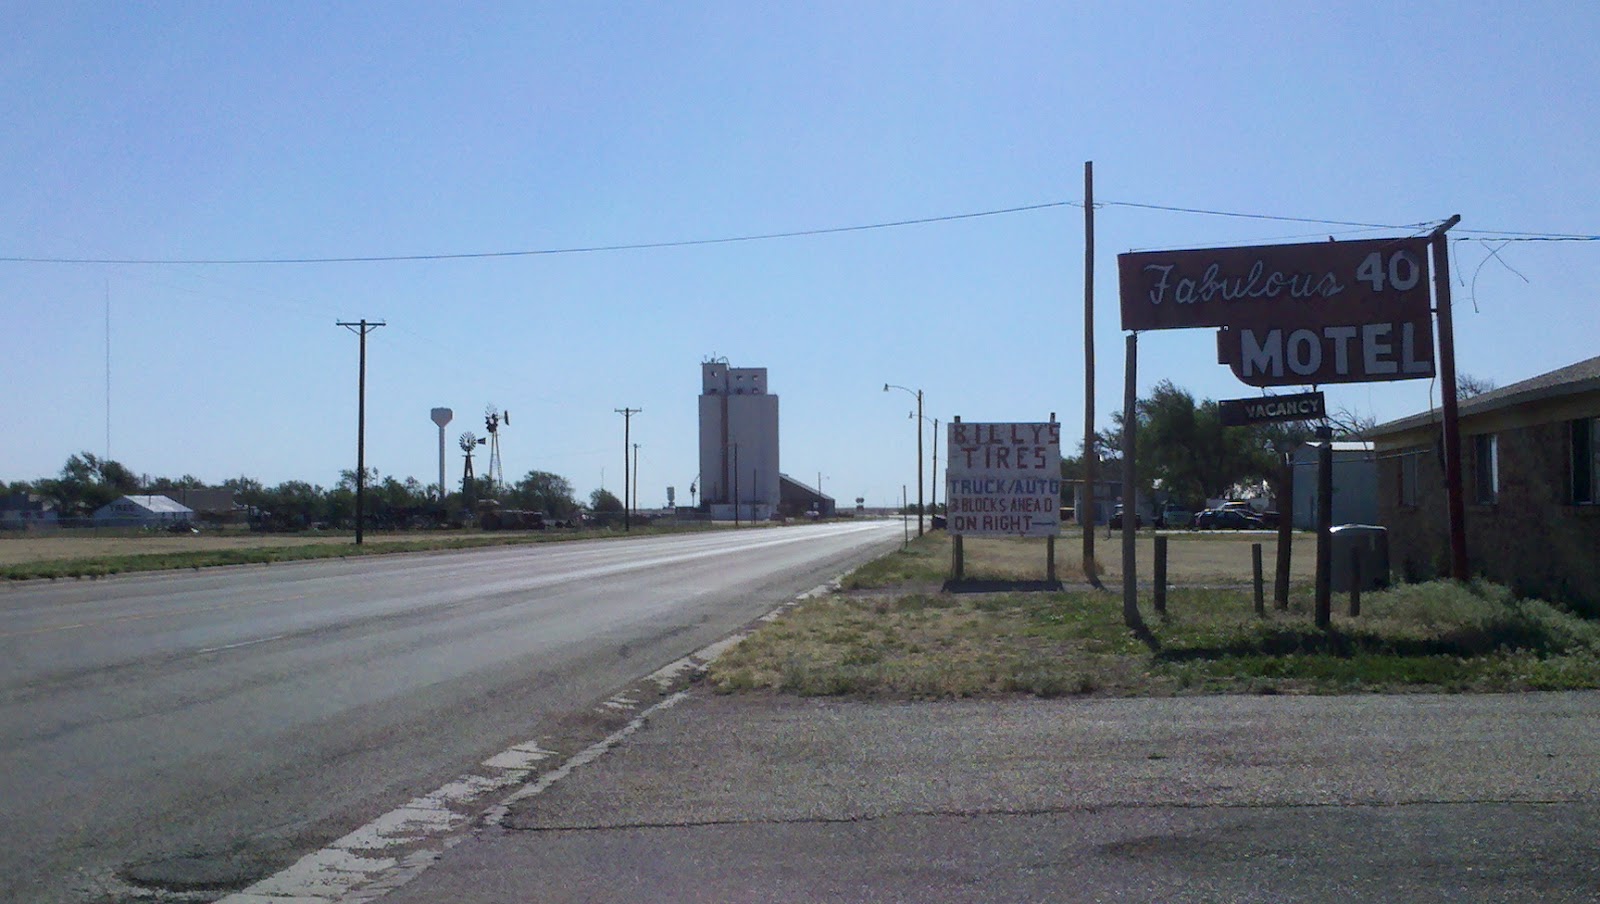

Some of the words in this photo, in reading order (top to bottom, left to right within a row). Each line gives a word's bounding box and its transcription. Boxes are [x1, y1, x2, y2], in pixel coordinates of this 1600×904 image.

[1144, 259, 1344, 305] Fabulous
[1356, 250, 1420, 292] 40
[1240, 322, 1431, 378] MOTEL
[1245, 400, 1319, 418] VACANCY
[961, 446, 1047, 470] TIRES
[950, 479, 1060, 495] TRUCK/AUTO
[962, 497, 1006, 513] BLOCKS
[1010, 497, 1053, 513] AHEAD
[954, 515, 977, 531] ON
[983, 515, 1033, 531] RIGHT
